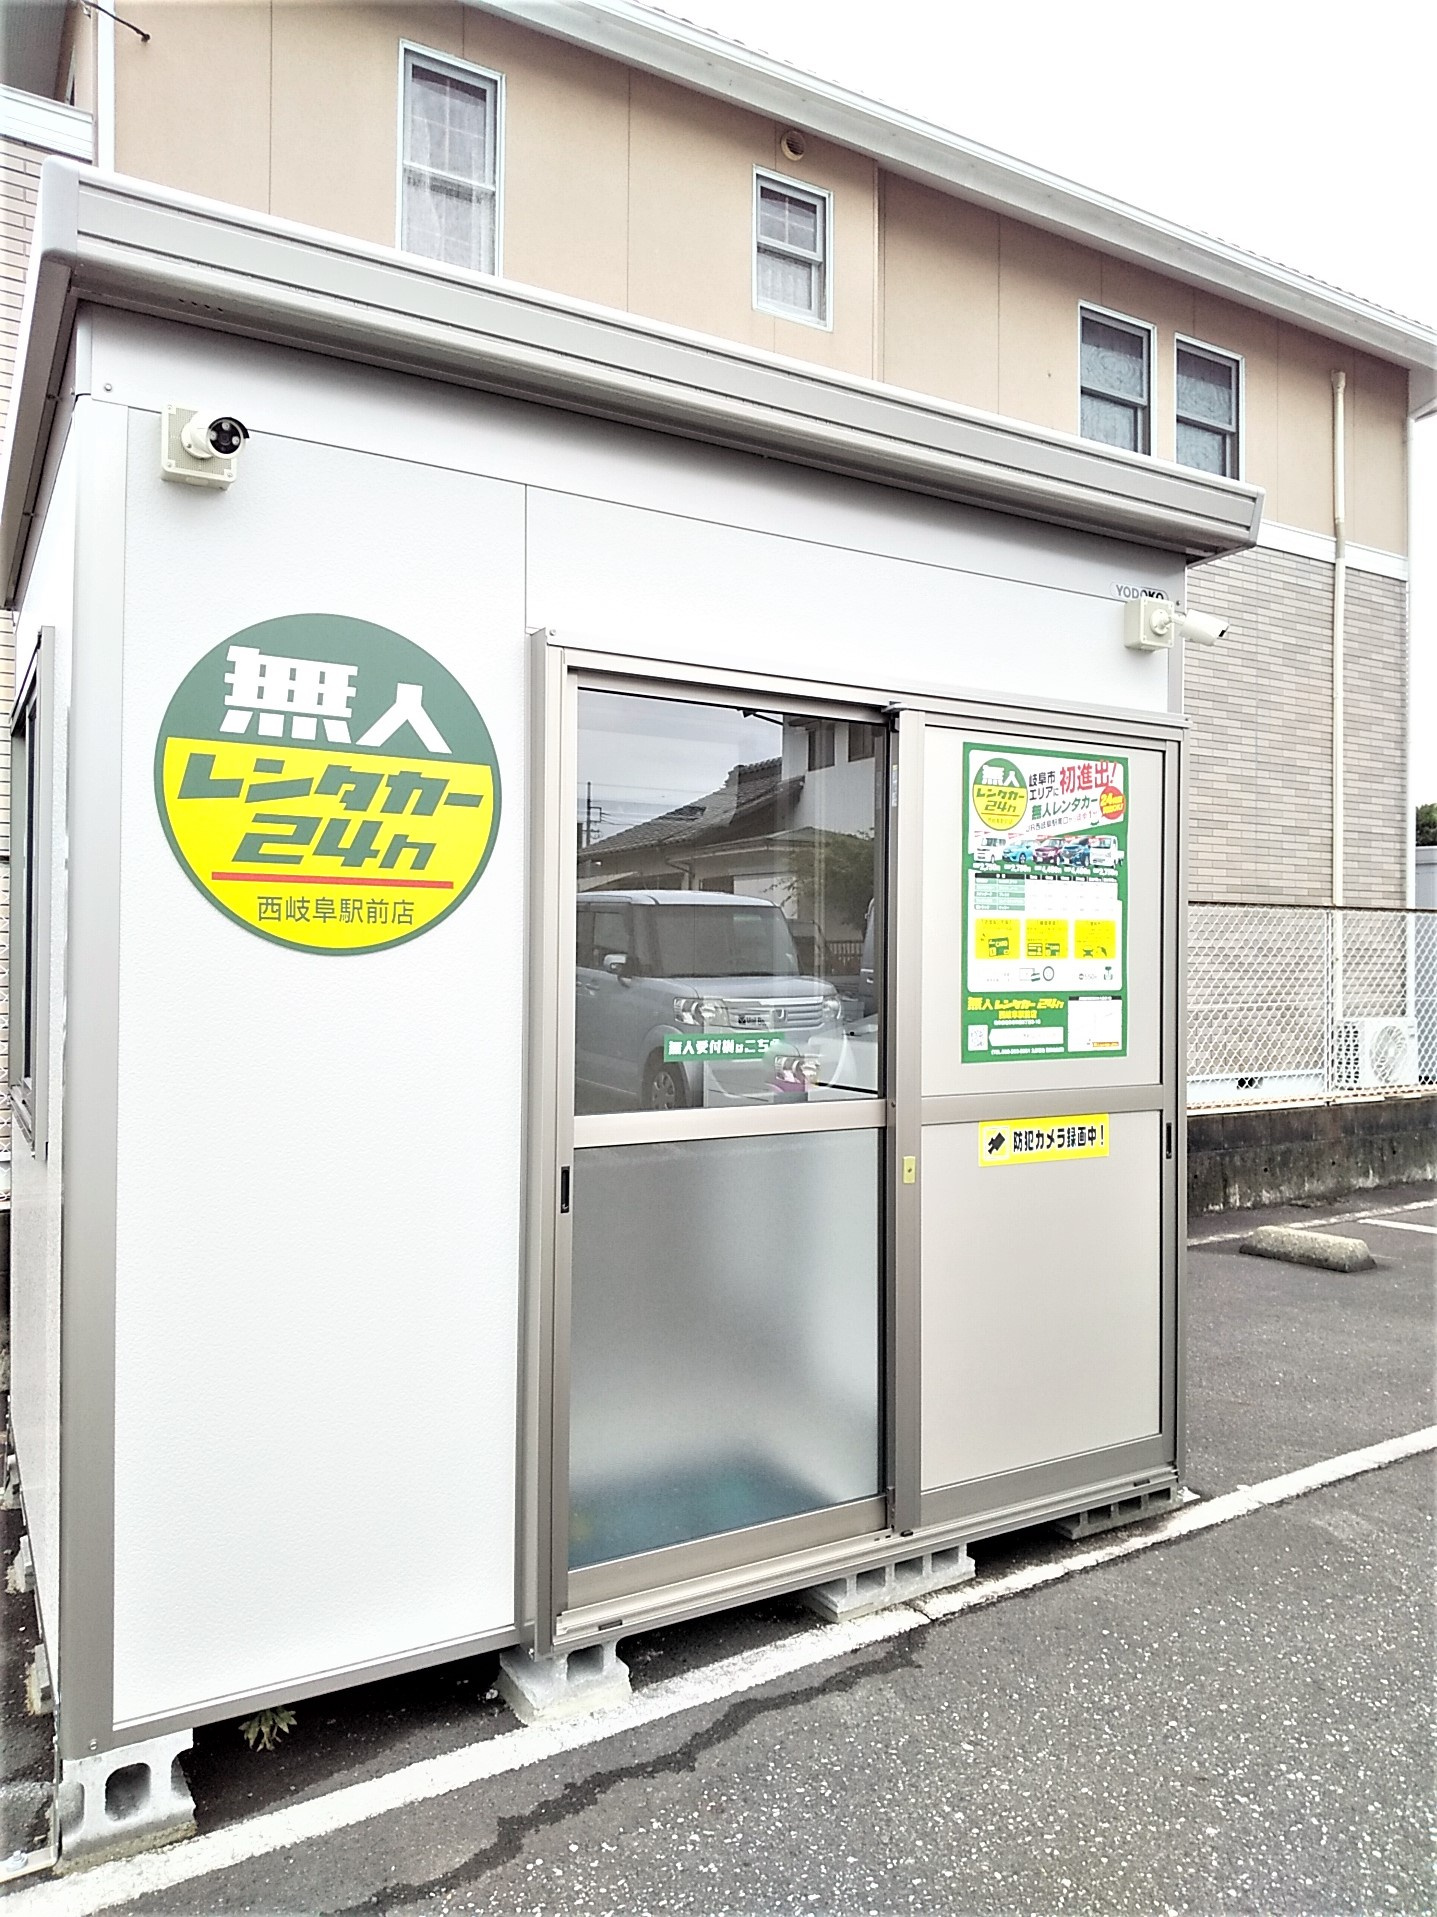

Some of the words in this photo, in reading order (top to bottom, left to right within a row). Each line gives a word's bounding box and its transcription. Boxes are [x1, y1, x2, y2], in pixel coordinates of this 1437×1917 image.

[219, 645, 453, 754] 無人
[177, 752, 485, 816] レンタカー
[981, 764, 1021, 788] 無人
[1028, 771, 1056, 788] 岐阜市
[976, 788, 1025, 801] レンタカー
[1029, 785, 1060, 801] エリアに
[1031, 795, 1099, 820] 無人レンタカー
[231, 812, 437, 871] 24h
[257, 895, 415, 926] 西岐阜駅前店
